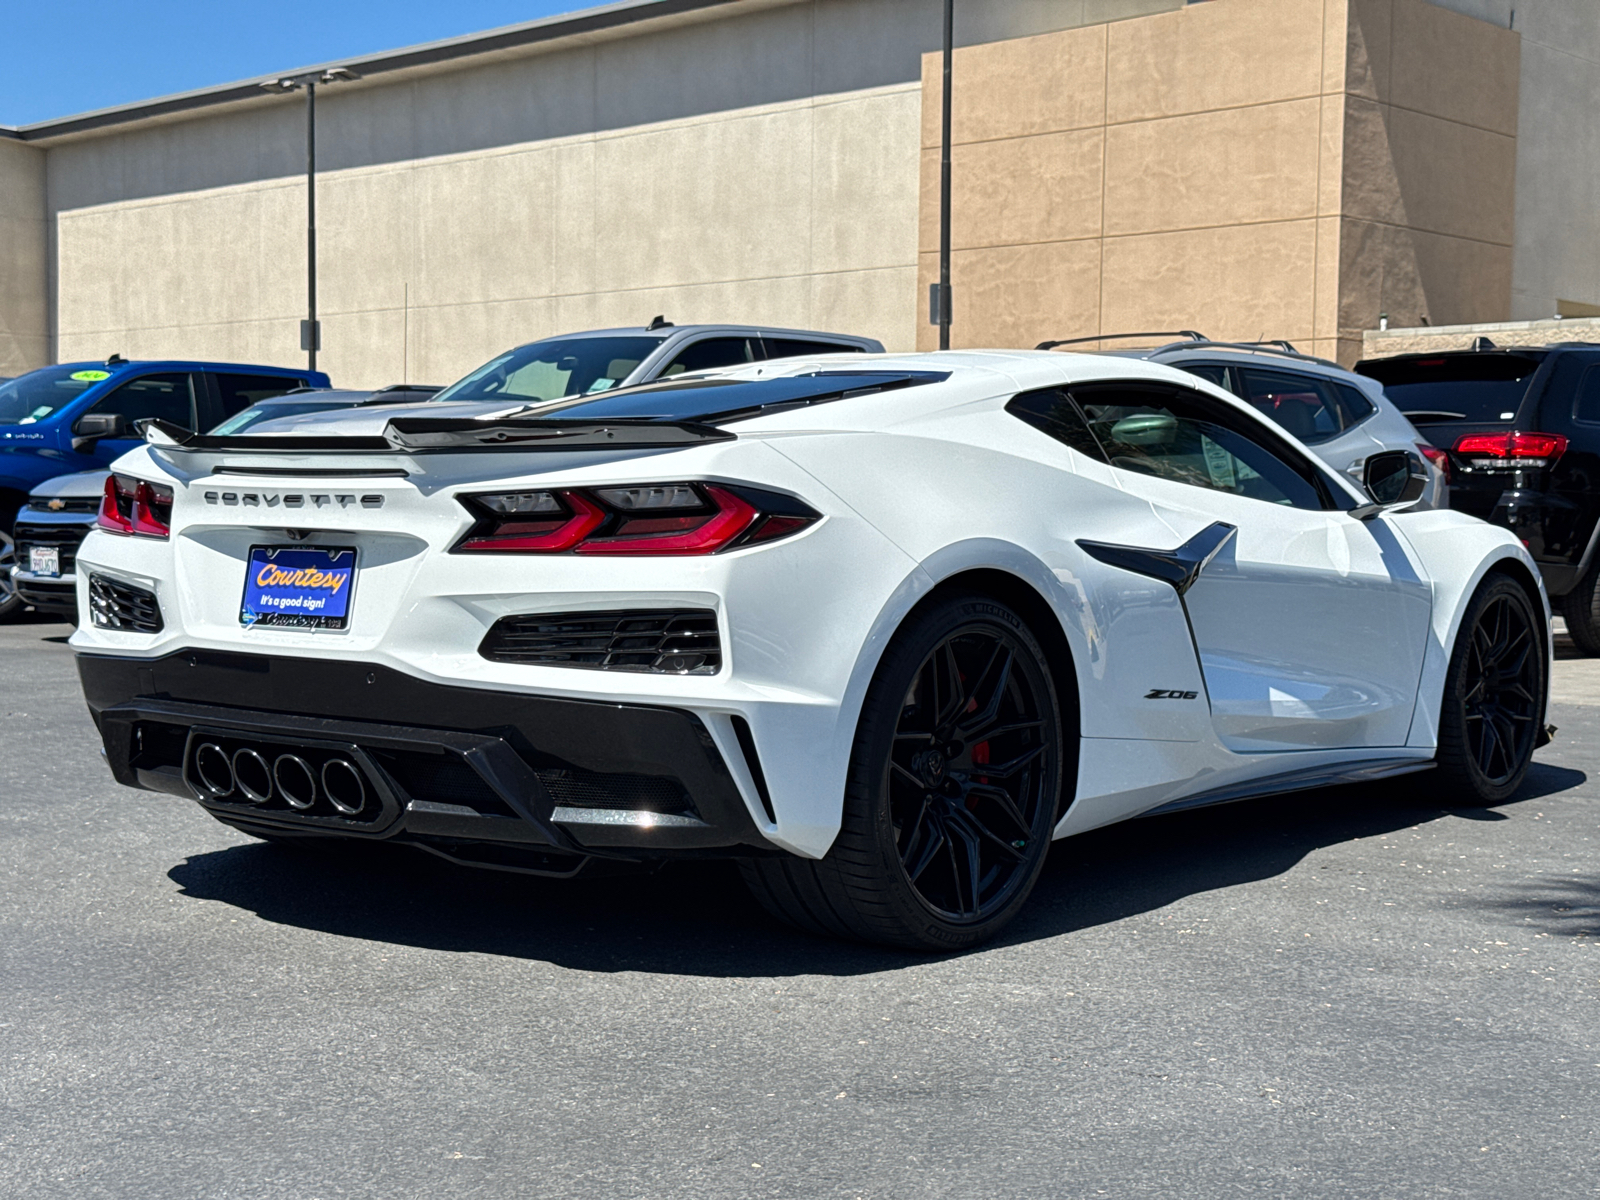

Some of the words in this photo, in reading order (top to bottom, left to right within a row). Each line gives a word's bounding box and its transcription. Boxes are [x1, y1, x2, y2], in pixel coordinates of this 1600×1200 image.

[204, 491, 385, 506] CORVETTE
[257, 563, 347, 594] Courtesy
[260, 594, 274, 606] It's
[279, 596, 302, 609] good
[303, 595, 326, 610] sign!
[975, 604, 1019, 627] MICHELIN
[1143, 688, 1199, 699] Z06
